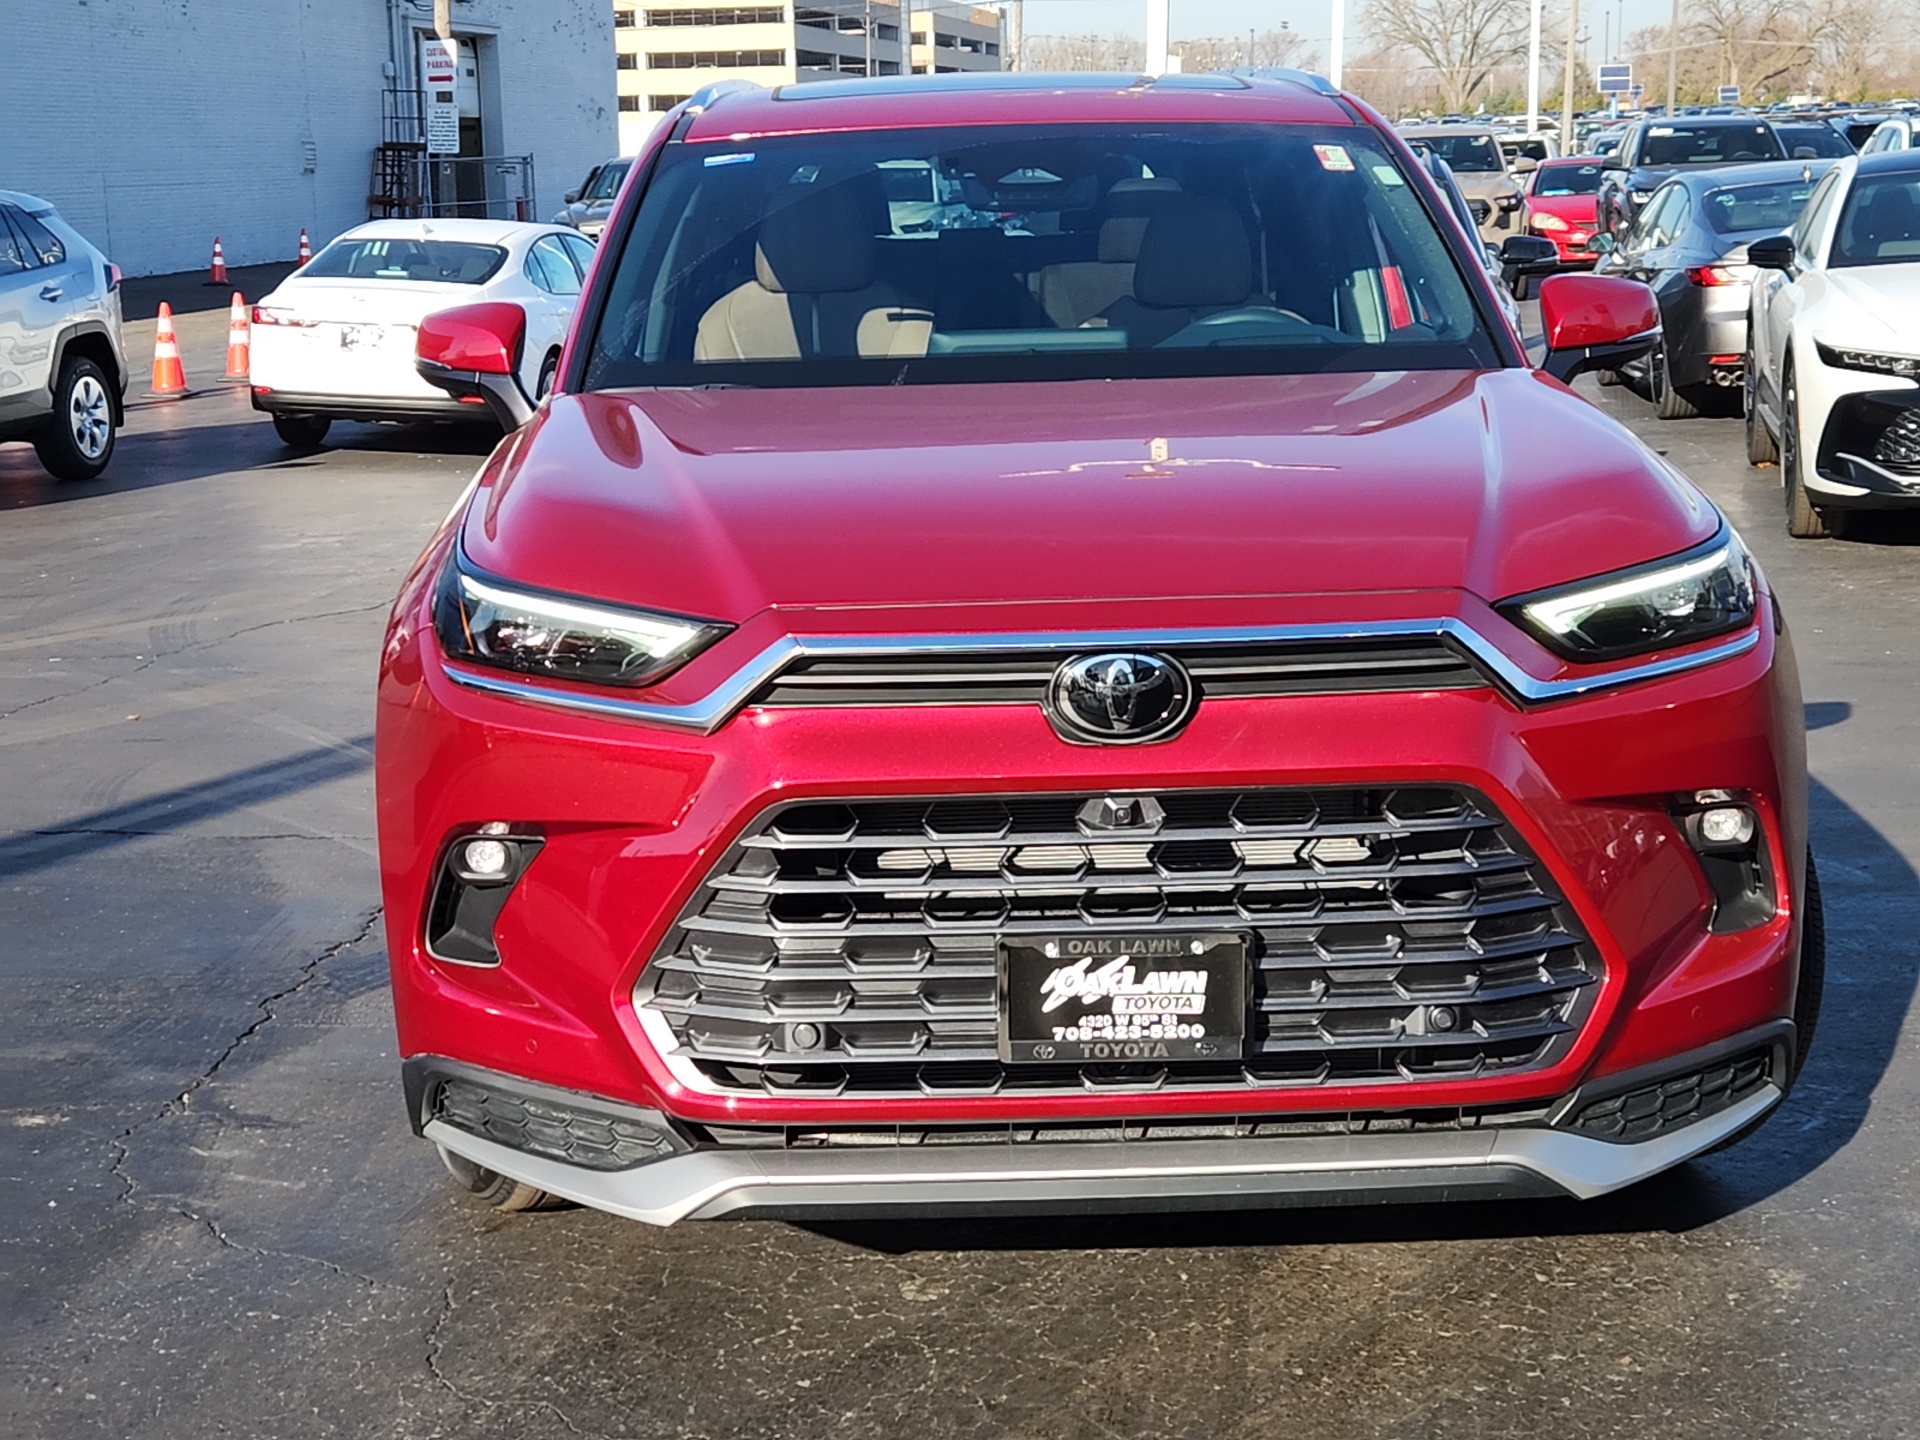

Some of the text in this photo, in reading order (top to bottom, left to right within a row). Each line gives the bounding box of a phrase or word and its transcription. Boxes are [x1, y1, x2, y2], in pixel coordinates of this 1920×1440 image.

[1068, 939, 1181, 954] OAK LAWN
[1123, 997, 1194, 1010] TOYOTA
[1078, 1015, 1113, 1027] 4320
[1115, 1015, 1129, 1026] W
[1161, 1014, 1178, 1025] St
[1052, 1024, 1205, 1041] 708-423-5200
[1080, 1043, 1170, 1058] TOYOTA
